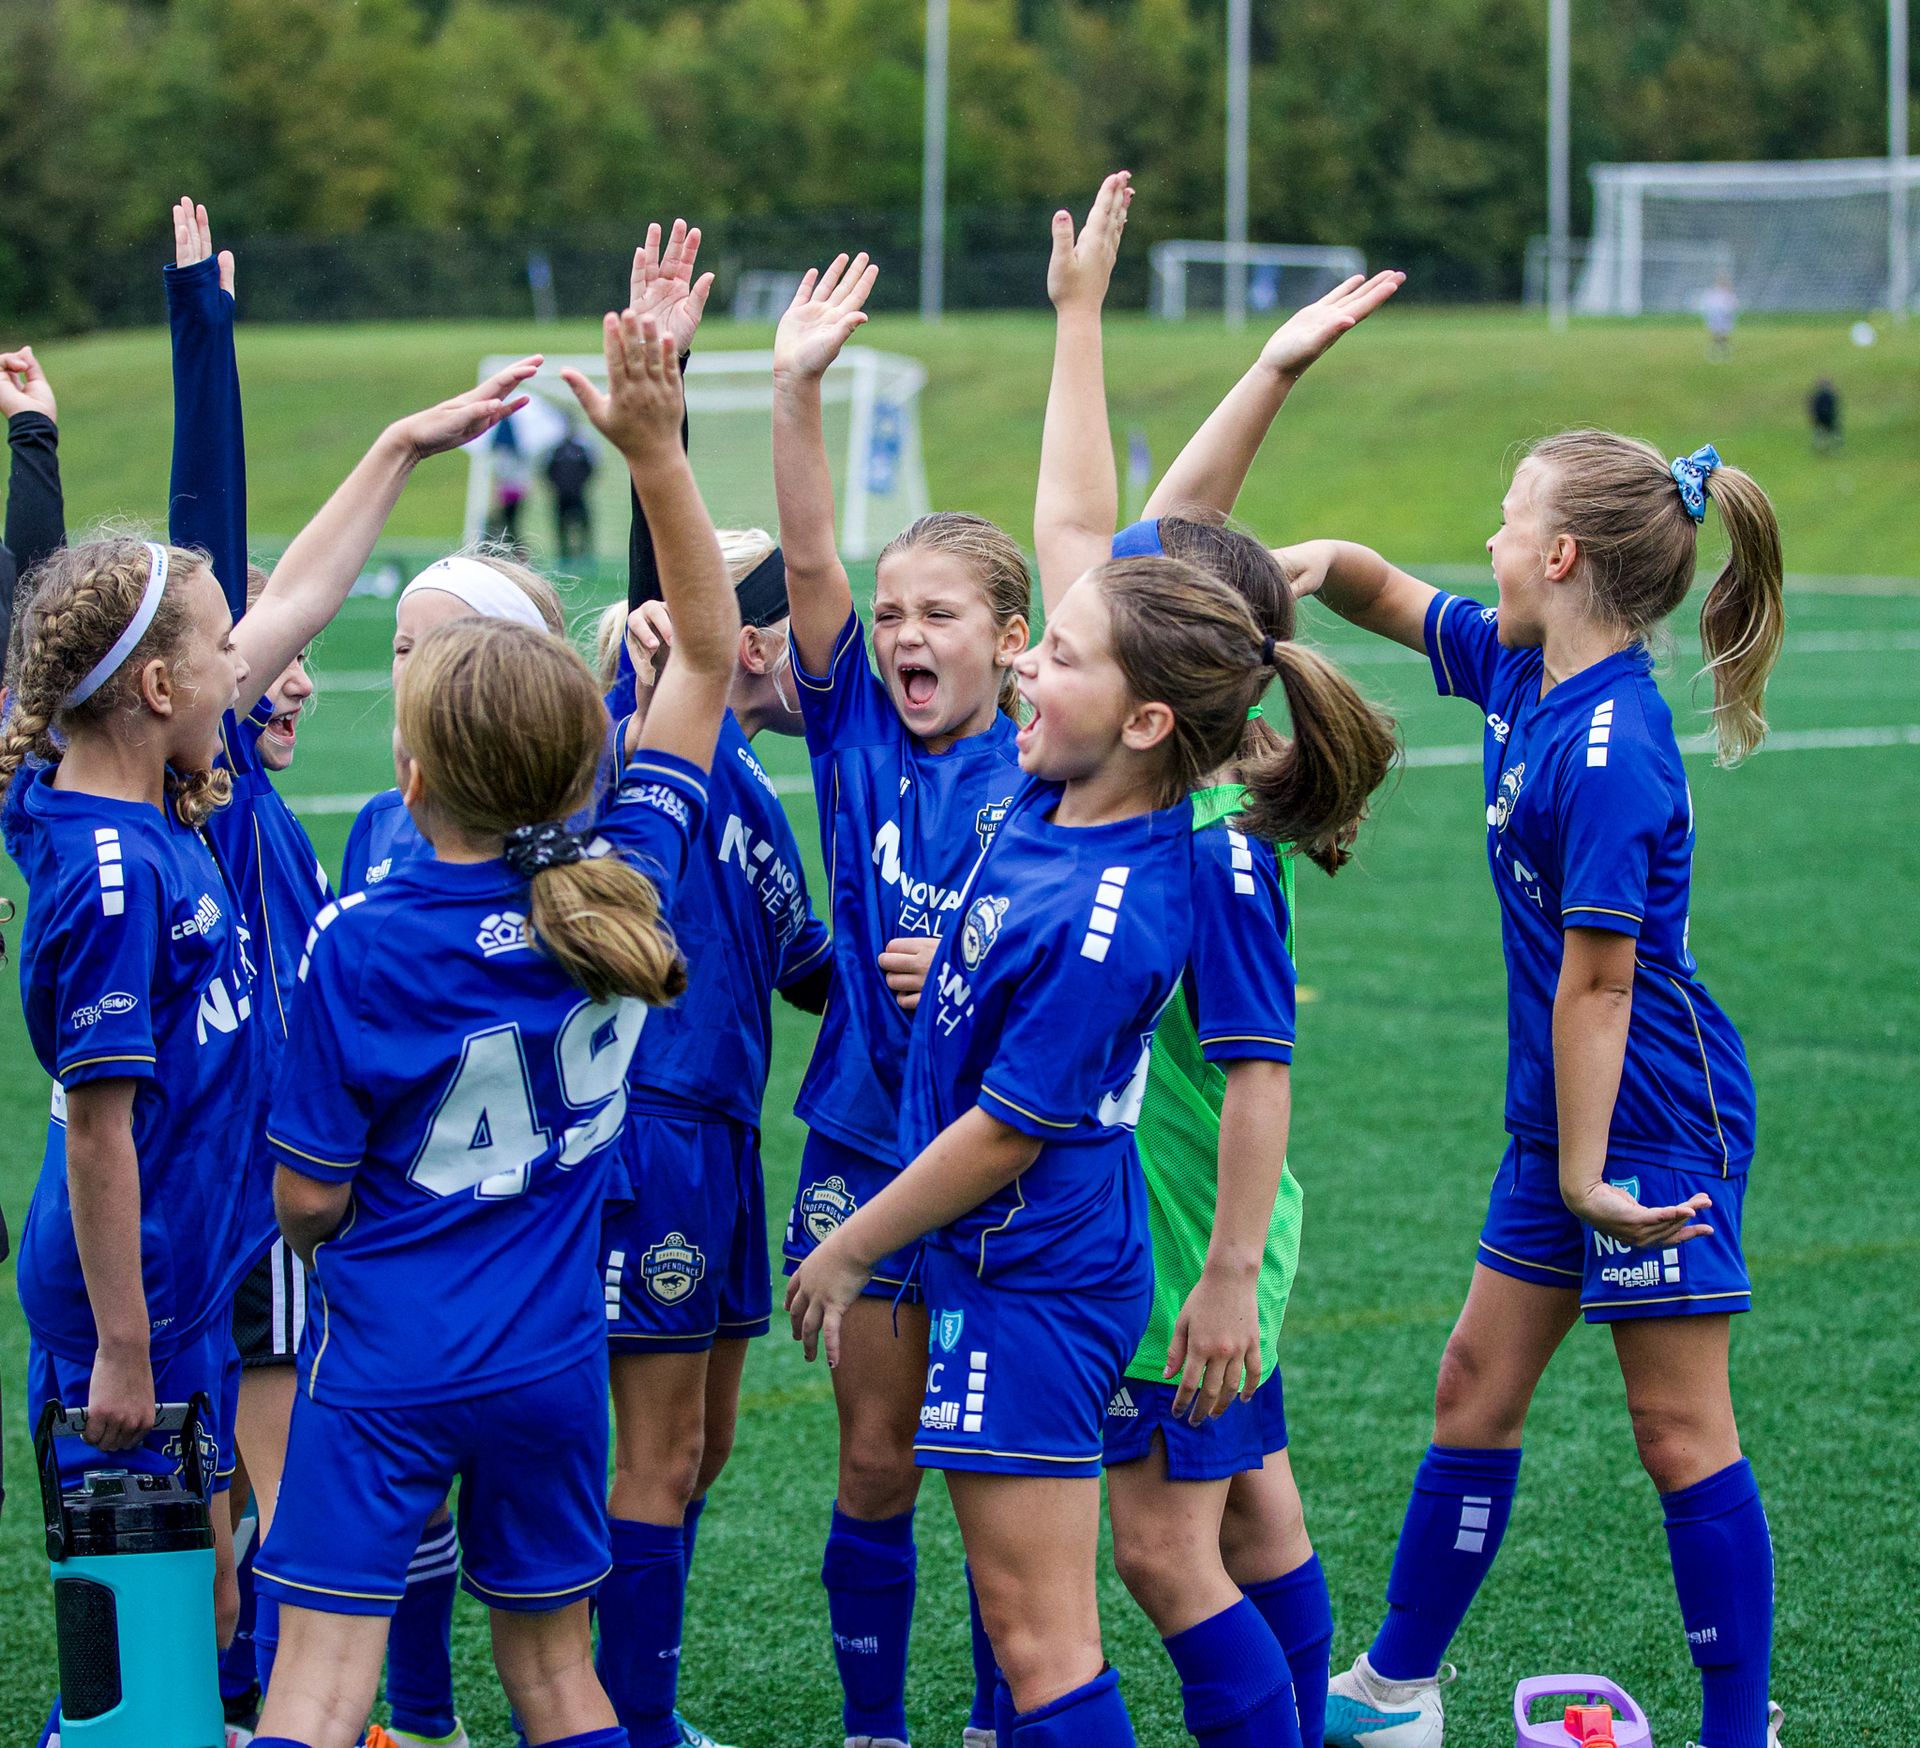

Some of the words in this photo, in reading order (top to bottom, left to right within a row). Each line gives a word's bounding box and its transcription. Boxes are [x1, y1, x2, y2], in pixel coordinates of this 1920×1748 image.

[171, 893, 219, 940] capelli
[202, 909, 223, 935] SPORT
[406, 995, 649, 1200] 49
[803, 1202, 848, 1225] INDEPENDENC
[645, 1261, 700, 1277] INDEPENDENCE
[1601, 1261, 1660, 1286] capelli
[1625, 1279, 1660, 1288] SPORT
[1108, 1406, 1139, 1417] adidas
